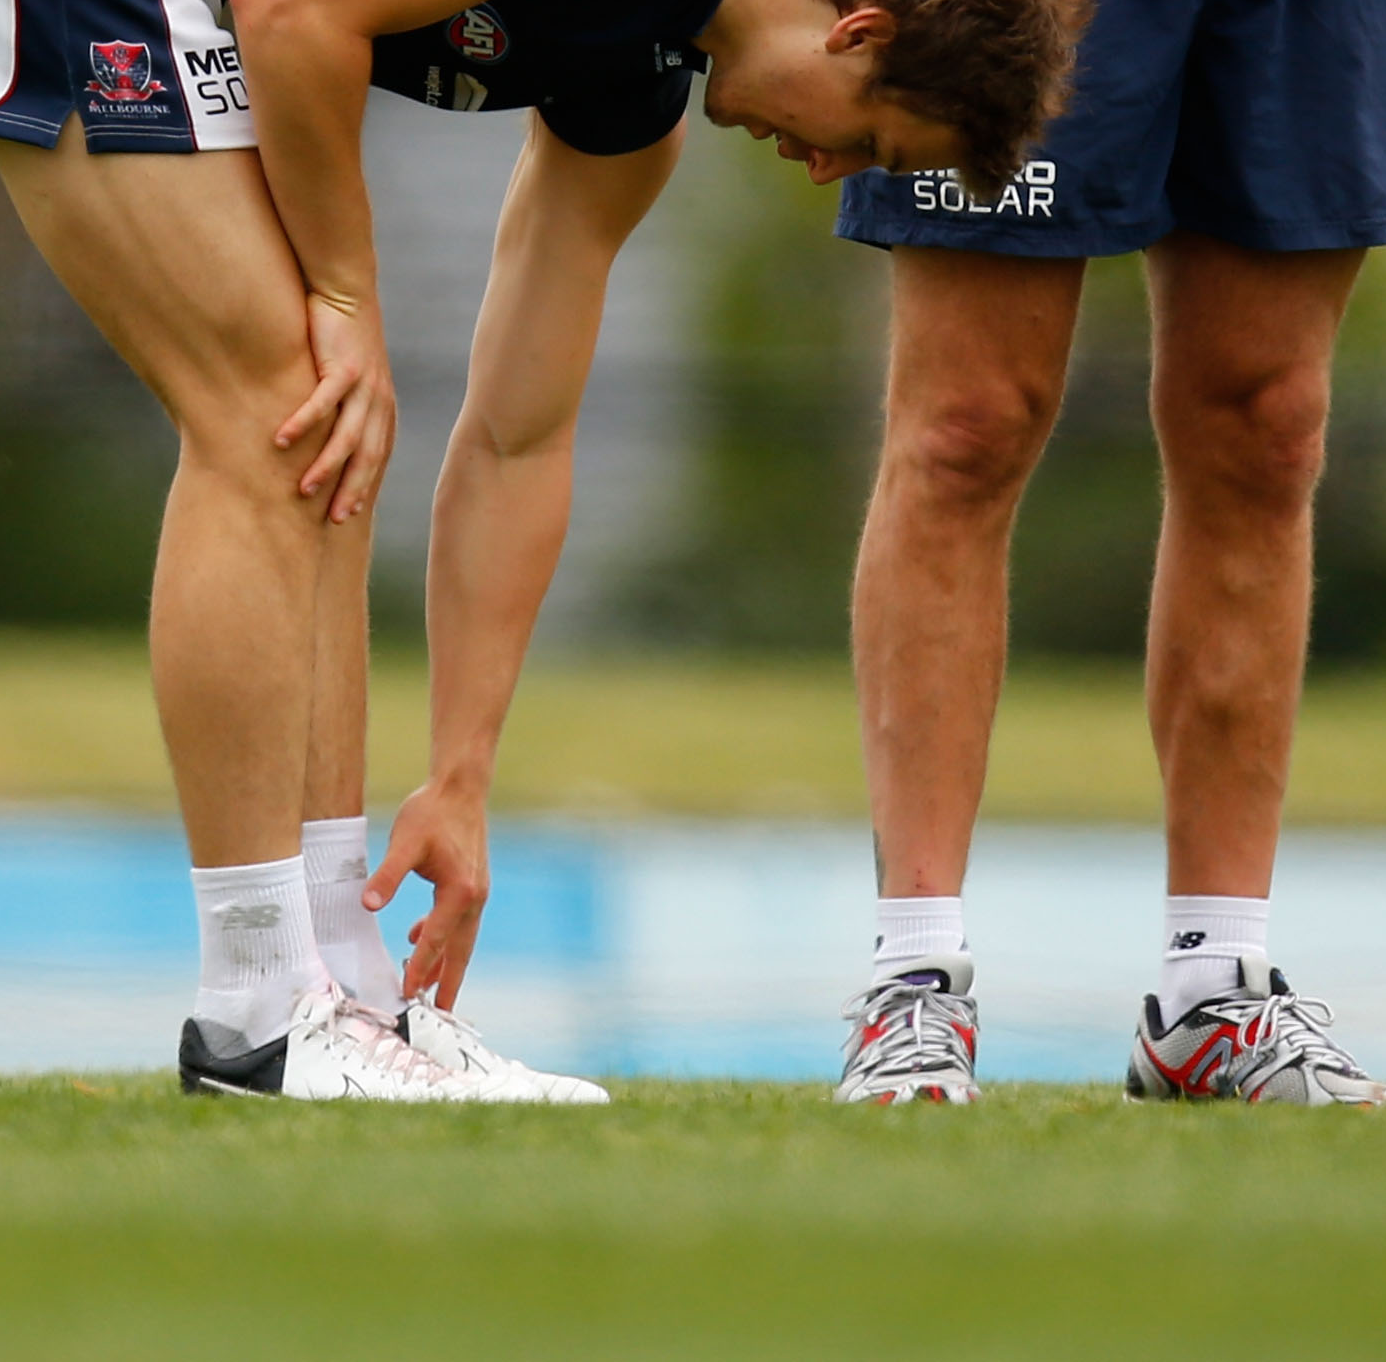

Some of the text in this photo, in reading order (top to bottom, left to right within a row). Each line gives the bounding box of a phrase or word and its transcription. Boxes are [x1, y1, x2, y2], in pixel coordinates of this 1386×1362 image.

[462, 8, 495, 58] AFL
[88, 100, 170, 115] MELBOURNE
[915, 180, 1056, 218] SOLAR
